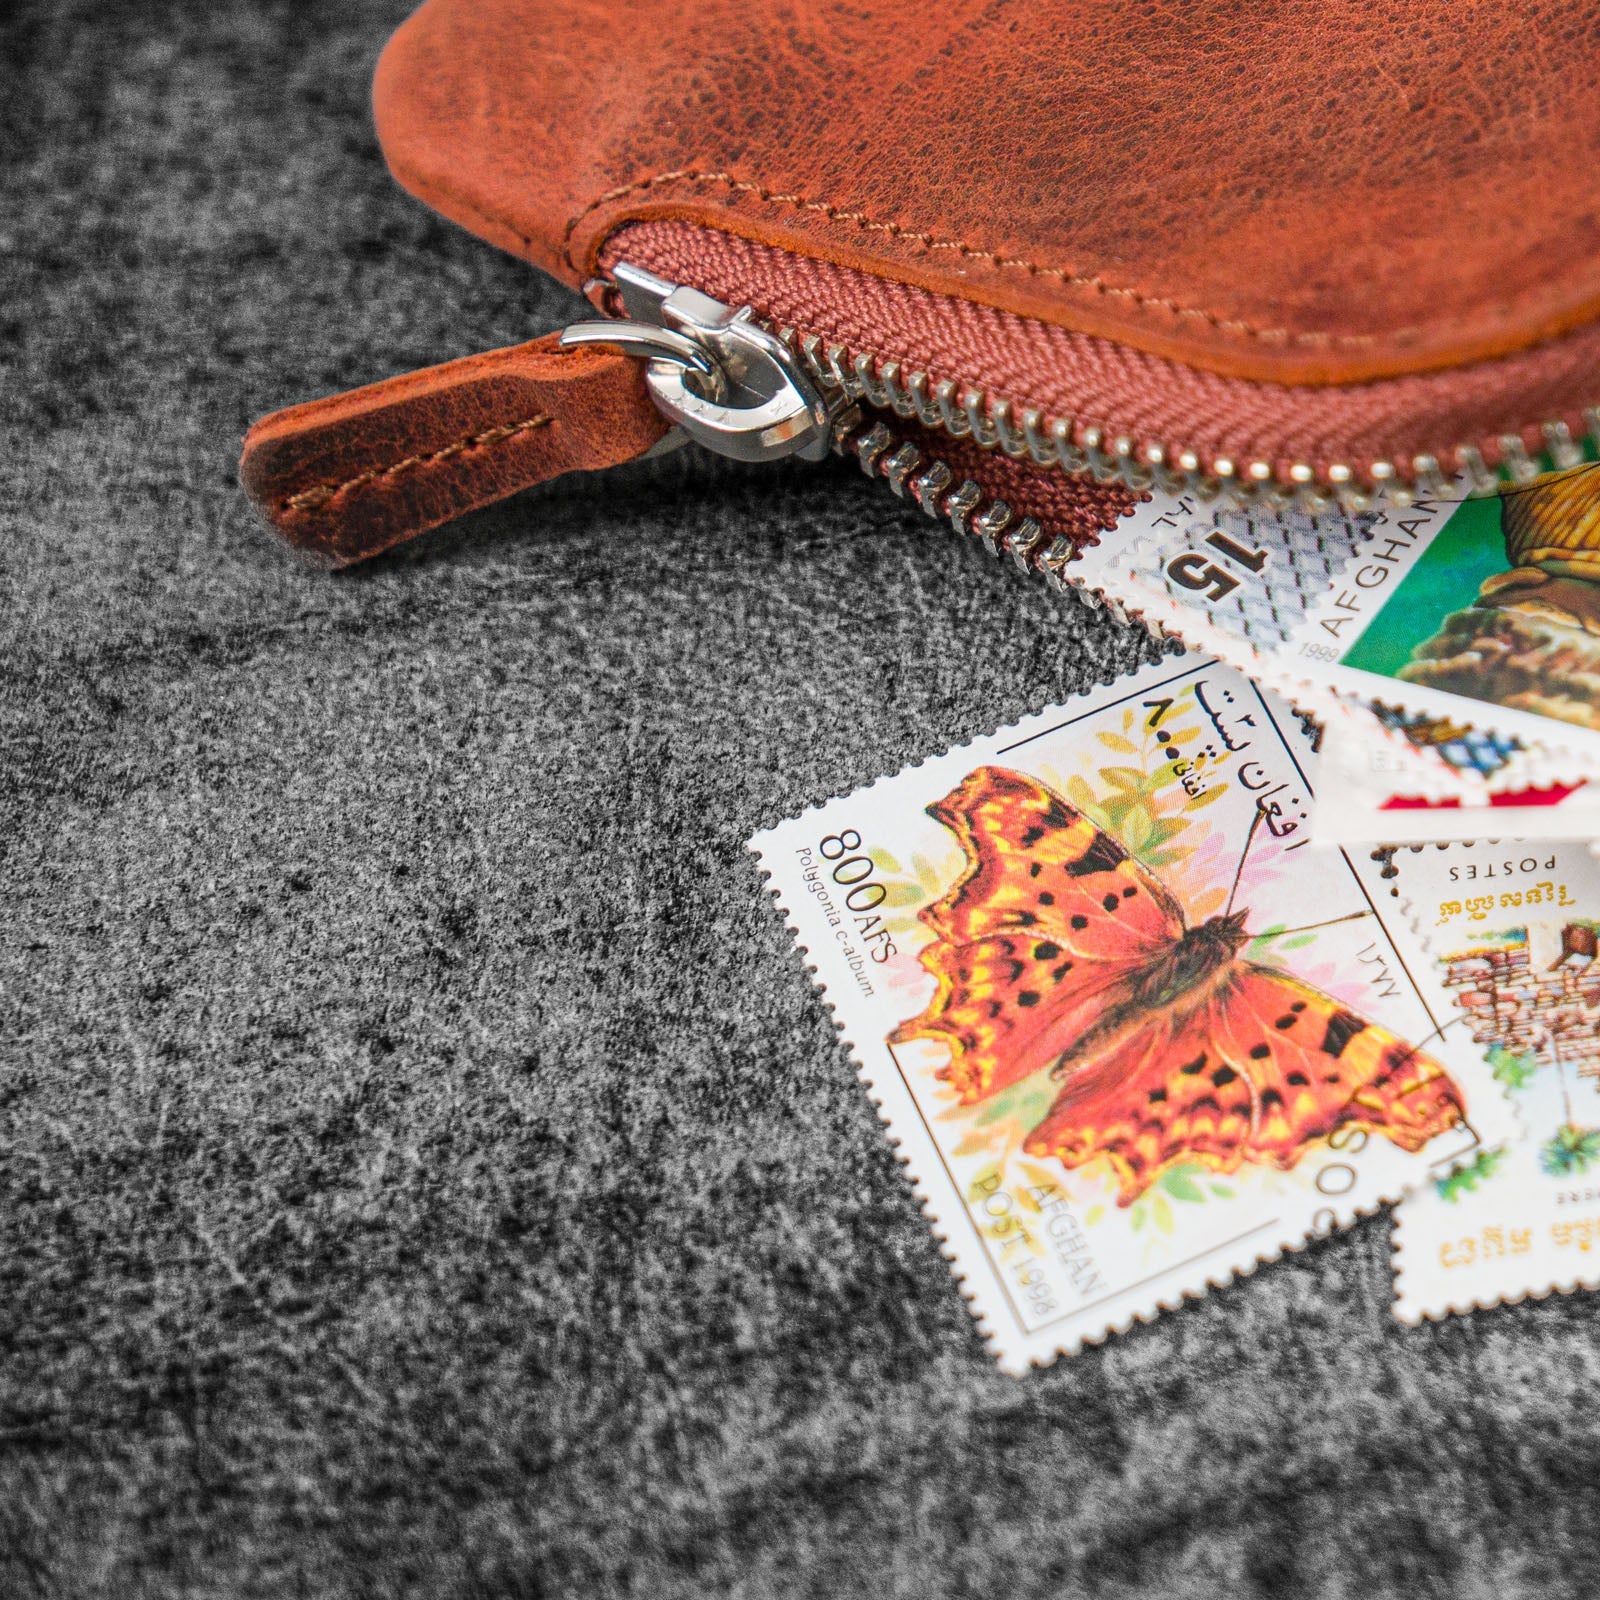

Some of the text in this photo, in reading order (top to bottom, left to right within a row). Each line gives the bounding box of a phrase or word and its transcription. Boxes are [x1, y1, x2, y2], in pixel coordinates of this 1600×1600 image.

[1165, 530, 1270, 602] 15
[1299, 641, 1341, 663] 1999
[795, 847, 841, 927] Polygonia
[820, 829, 898, 964] 800 AFS
[1449, 855, 1557, 883] POSTES
[972, 1172, 1033, 1249] POST
[1027, 1183, 1108, 1296] AFGHAN
